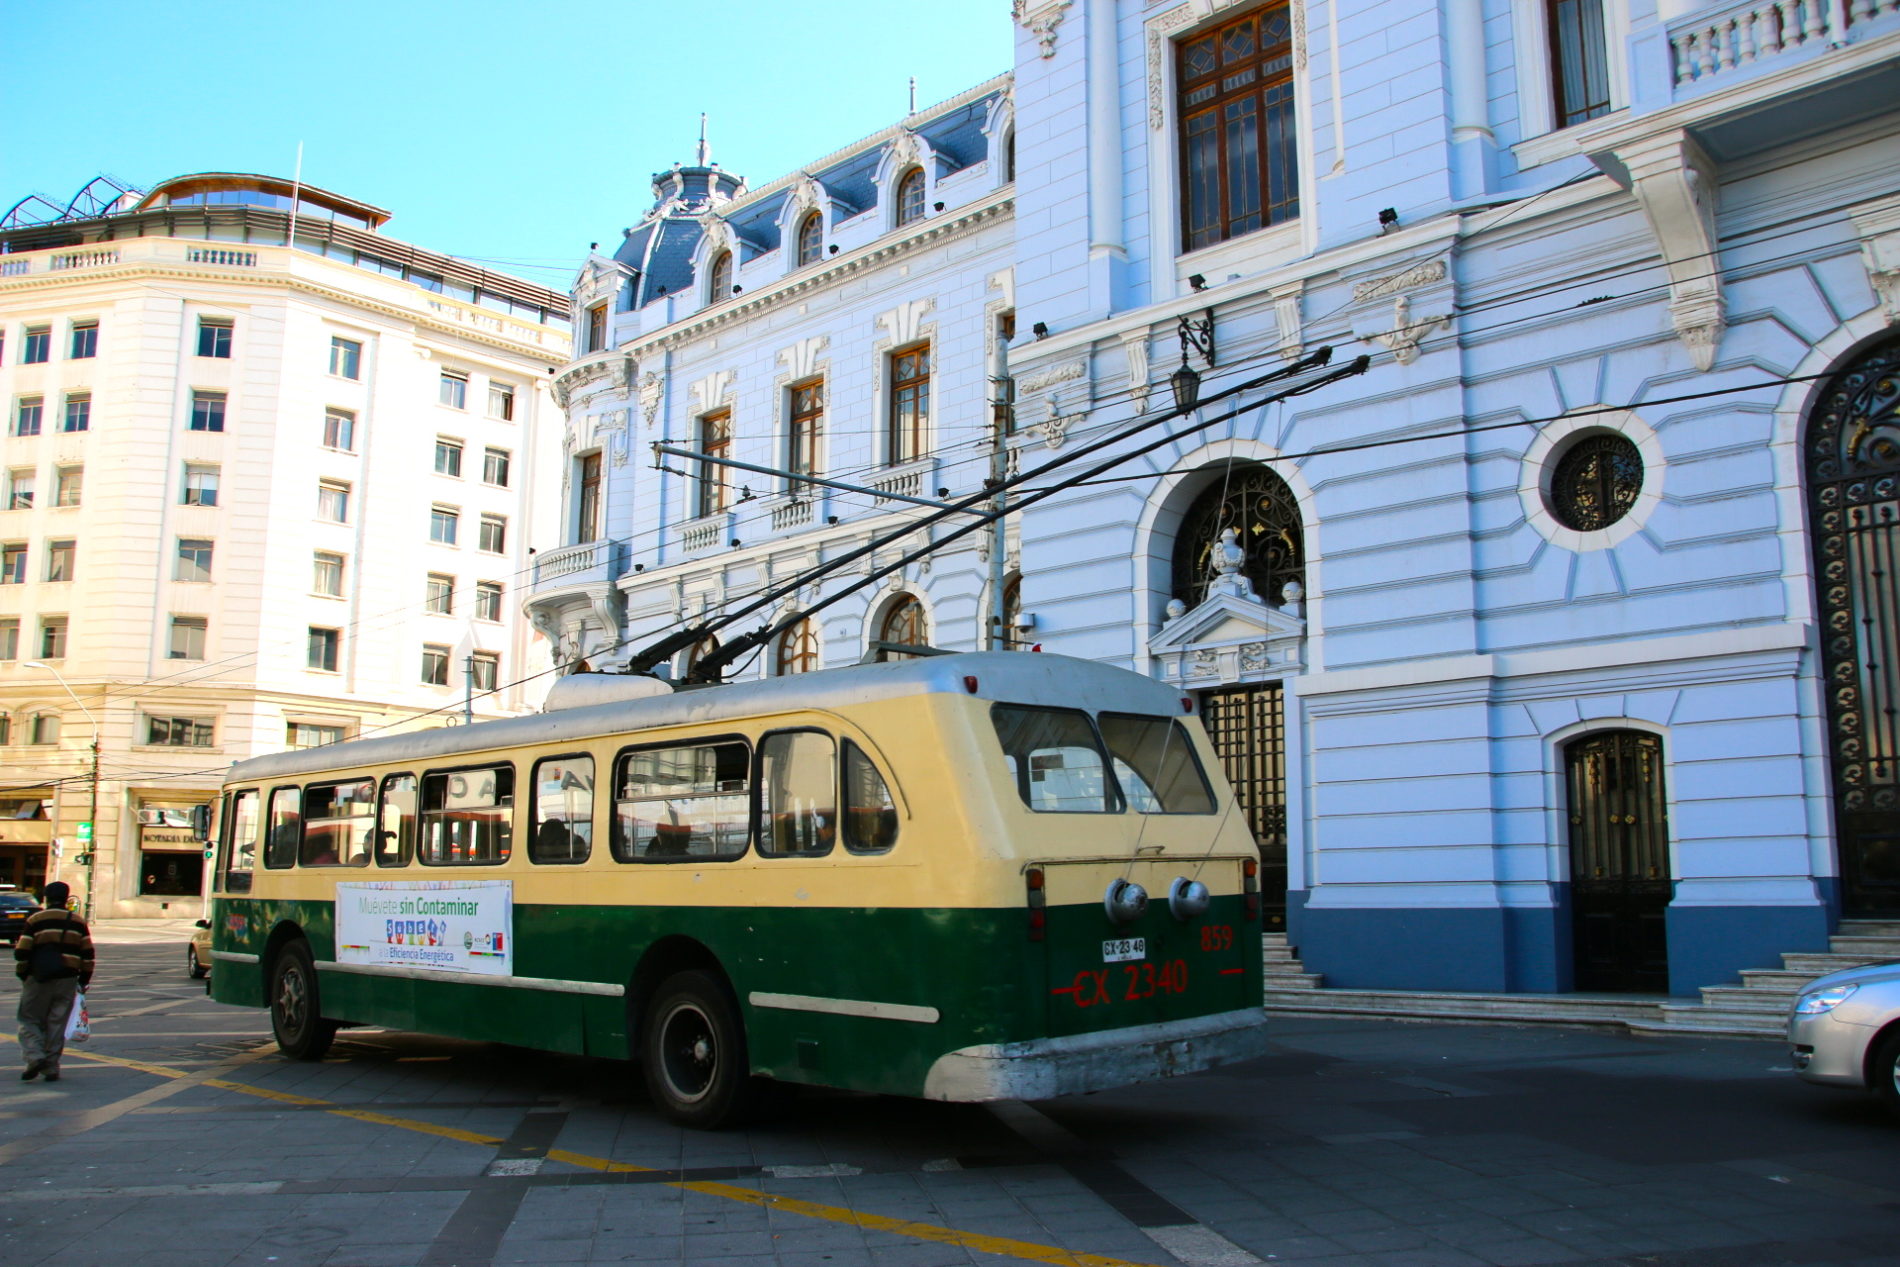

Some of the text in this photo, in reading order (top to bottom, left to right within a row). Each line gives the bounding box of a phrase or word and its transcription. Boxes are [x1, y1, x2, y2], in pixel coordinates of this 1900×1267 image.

[359, 896, 479, 917] Muévete sin Contaminar
[1201, 925, 1232, 951] 859
[390, 946, 418, 959] Eficiencia
[420, 949, 454, 963] Energética
[1125, 959, 1187, 1000] 2340
